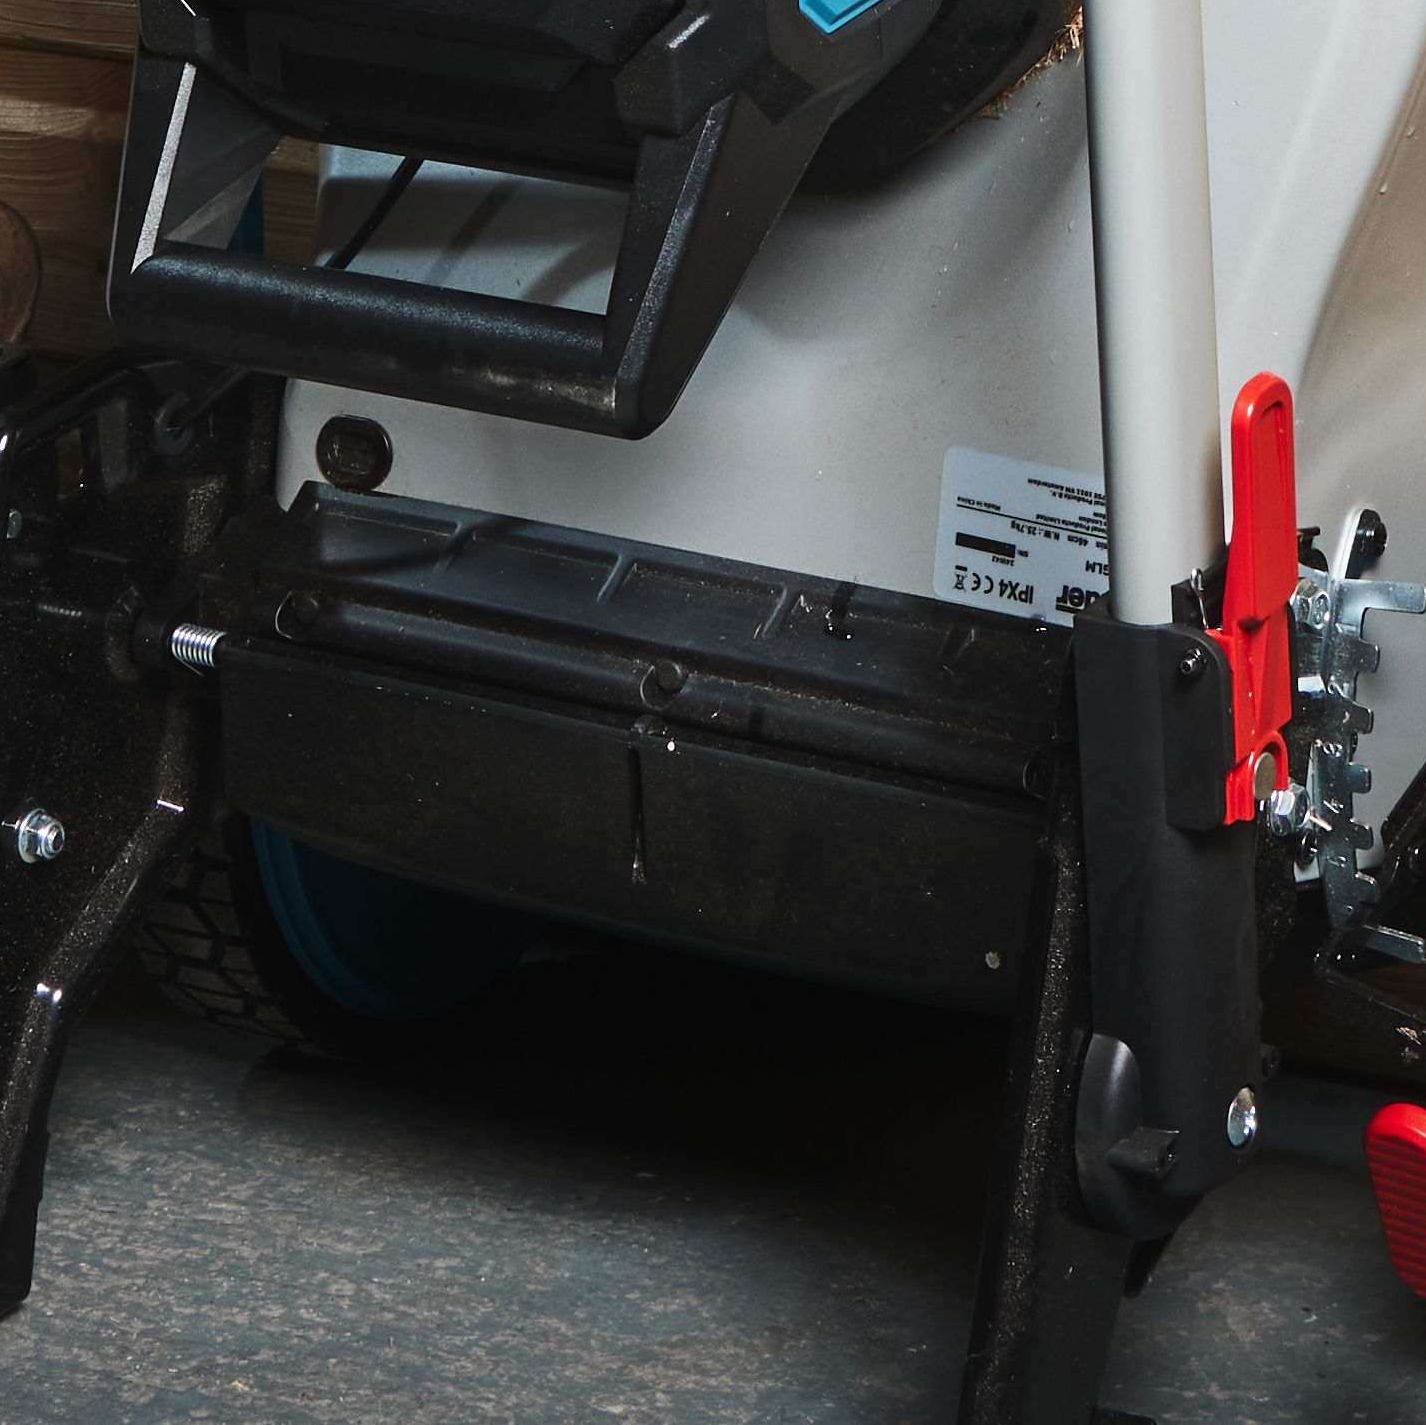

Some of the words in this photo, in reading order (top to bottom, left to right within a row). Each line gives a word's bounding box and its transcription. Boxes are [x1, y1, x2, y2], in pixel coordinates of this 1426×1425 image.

[957, 496, 975, 506] China
[984, 502, 1001, 511] Made
[999, 579, 1034, 604] IPX4
